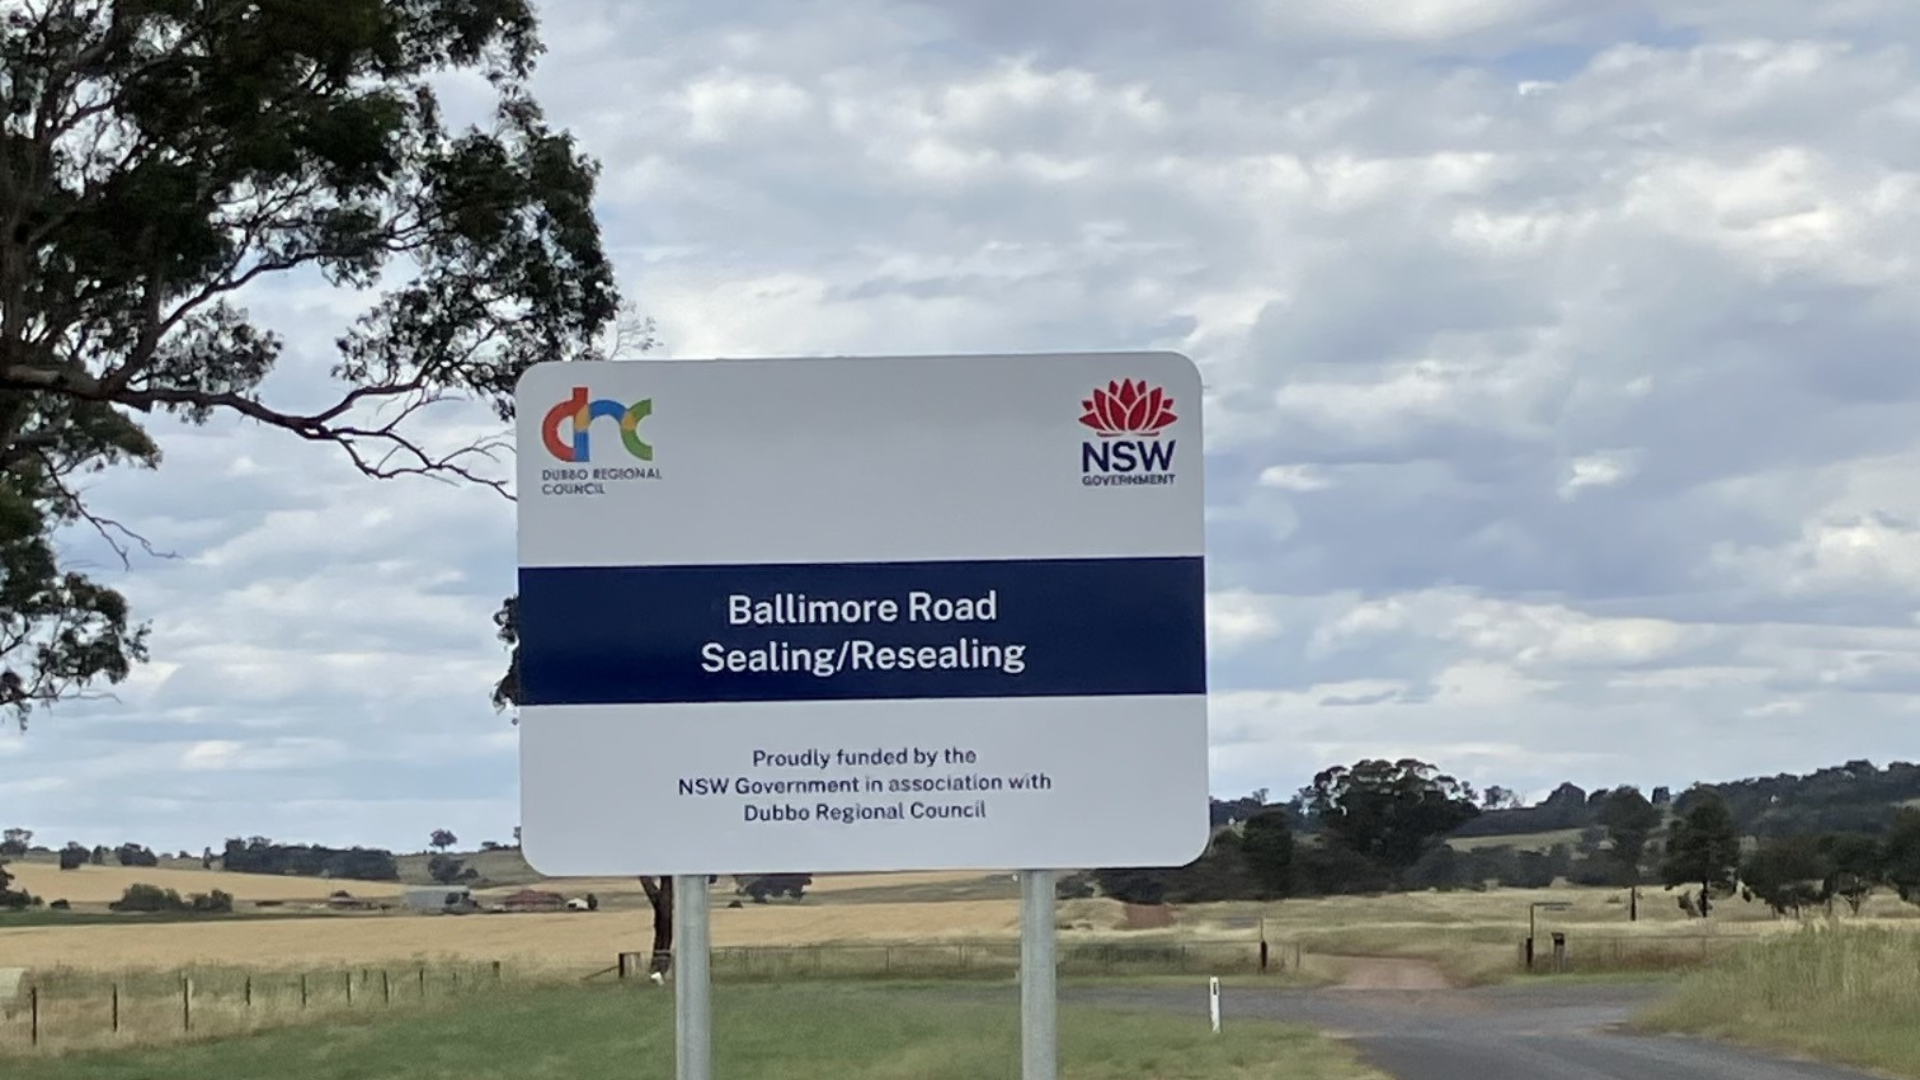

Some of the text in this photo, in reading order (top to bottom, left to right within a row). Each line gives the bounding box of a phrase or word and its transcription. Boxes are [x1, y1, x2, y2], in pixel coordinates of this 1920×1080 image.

[1082, 440, 1176, 473] NSW
[542, 468, 662, 481] DUBBO REGIONAL
[1082, 474, 1176, 486] GOVERNMENT
[542, 483, 605, 495] COUNCIL
[729, 590, 998, 625] Ballimore Road
[701, 638, 1026, 678] Sealing/Resealing
[752, 746, 977, 769] Proudly funded by the
[678, 772, 1052, 796] NSW Government in association with
[744, 800, 986, 824] Dubbo Regional Council
